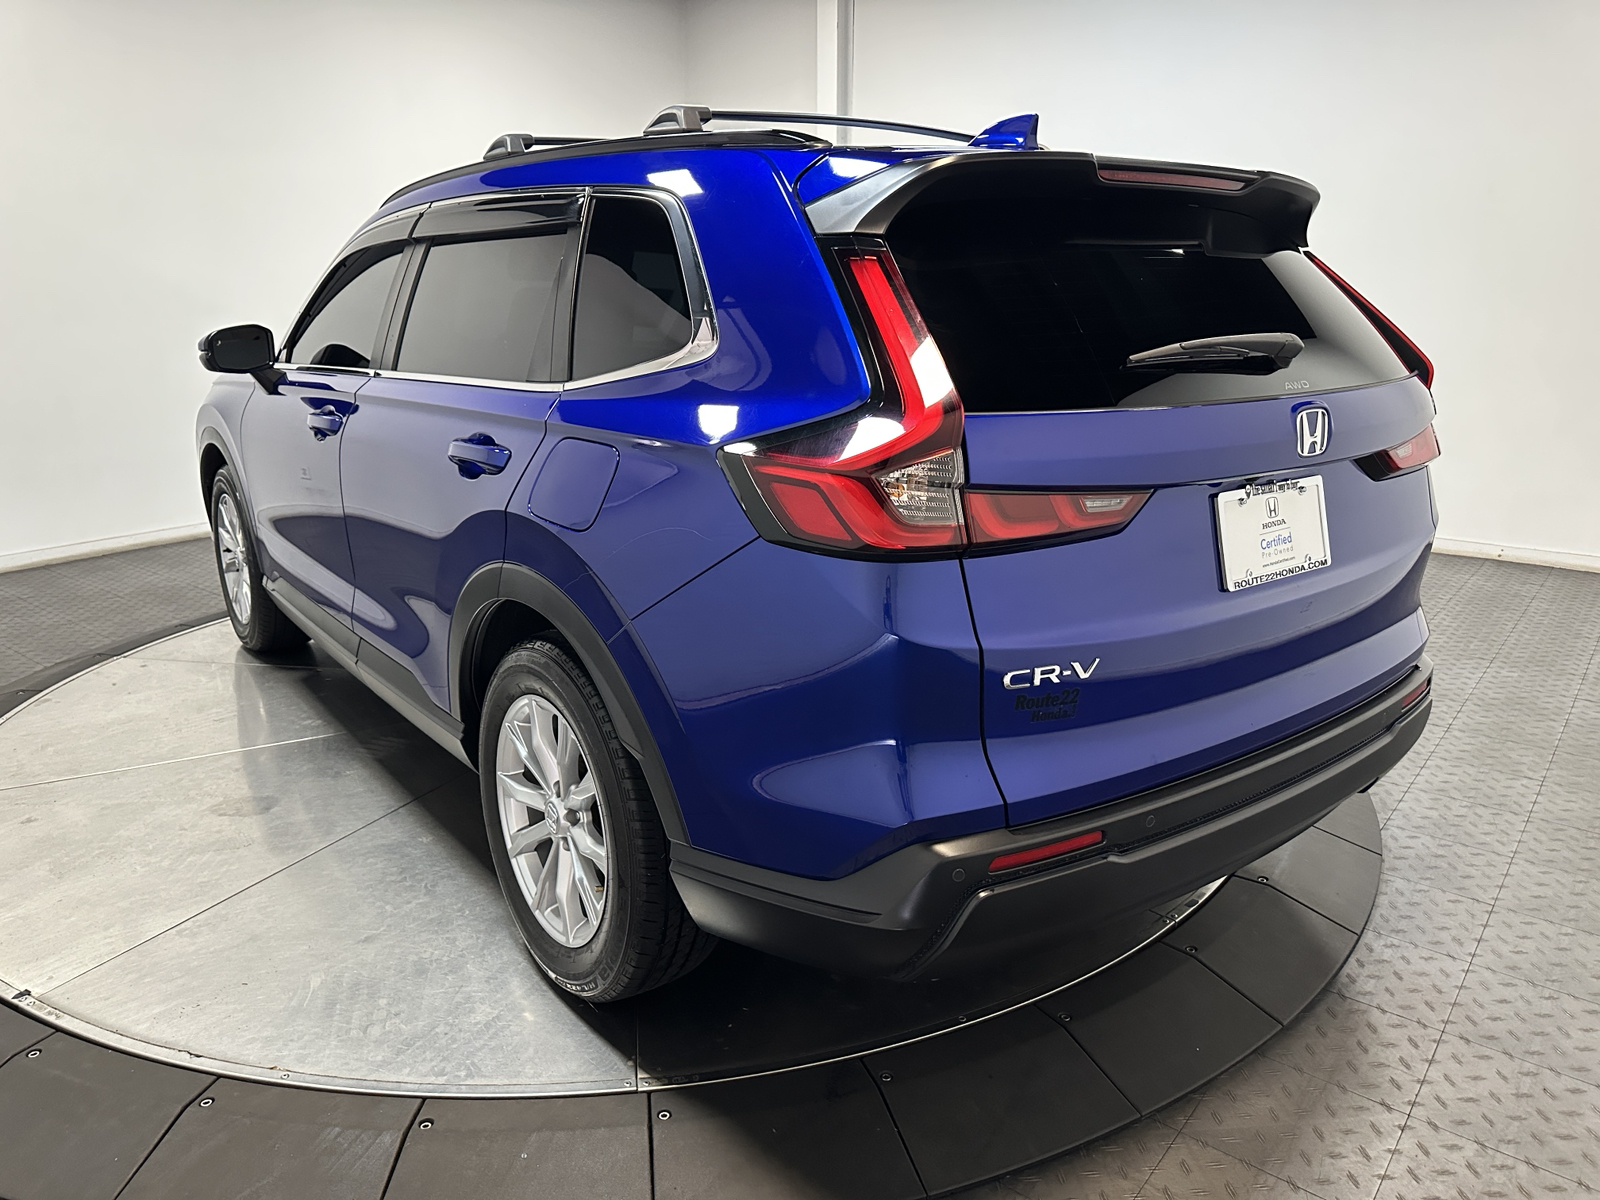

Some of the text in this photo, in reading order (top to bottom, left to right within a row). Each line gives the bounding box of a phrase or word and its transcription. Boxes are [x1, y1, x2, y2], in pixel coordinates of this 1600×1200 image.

[1284, 380, 1310, 391] AWD
[1261, 518, 1287, 530] HONDA
[1260, 532, 1293, 550] Certified
[1261, 546, 1294, 559] Pre-Owned
[1233, 558, 1328, 590] ROUTE22HONDA.COM
[1003, 657, 1101, 690] CR-V
